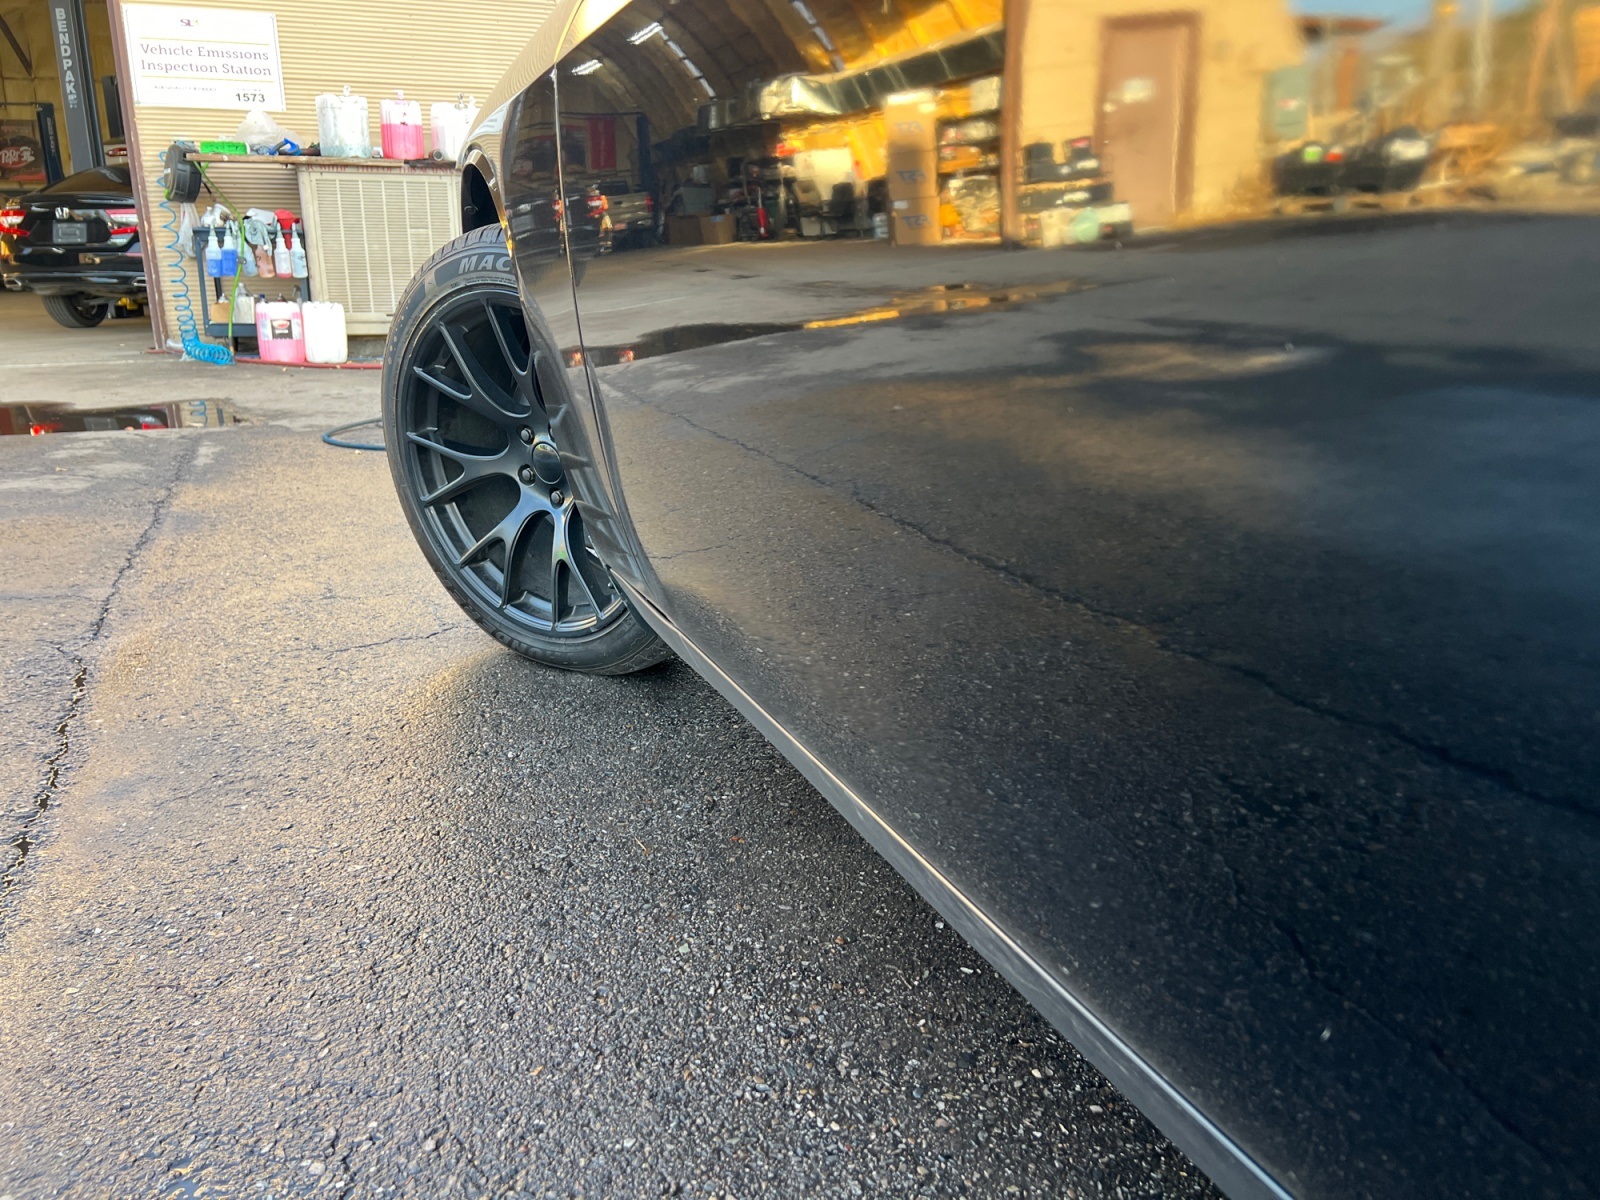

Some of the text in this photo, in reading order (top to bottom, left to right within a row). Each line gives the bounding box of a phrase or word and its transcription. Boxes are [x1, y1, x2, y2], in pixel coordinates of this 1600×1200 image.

[55, 8, 76, 94] BENDPAK
[140, 44, 269, 60] Vehicle Emissions
[141, 60, 272, 76] Inspection Station
[235, 93, 266, 103] 1573
